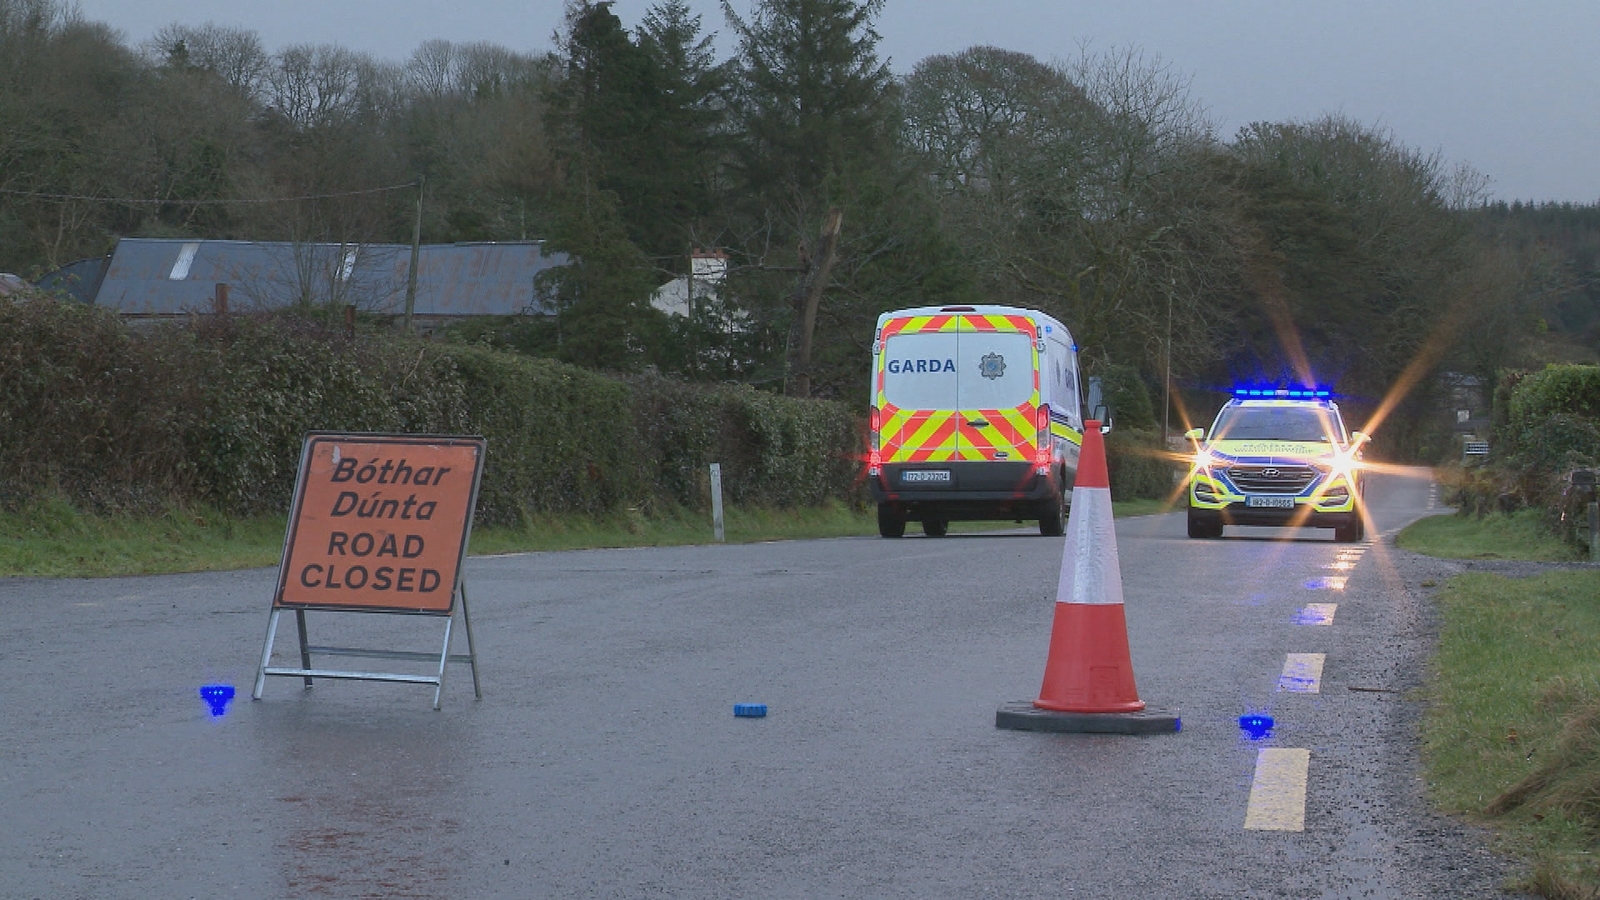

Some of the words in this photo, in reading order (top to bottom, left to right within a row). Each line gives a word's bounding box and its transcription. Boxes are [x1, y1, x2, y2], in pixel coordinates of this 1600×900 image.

[888, 359, 956, 374] GARDA
[330, 457, 451, 486] Bóthar
[330, 491, 438, 520] Dúnta
[327, 531, 425, 559] ROAD
[300, 563, 441, 593] CLOSED
